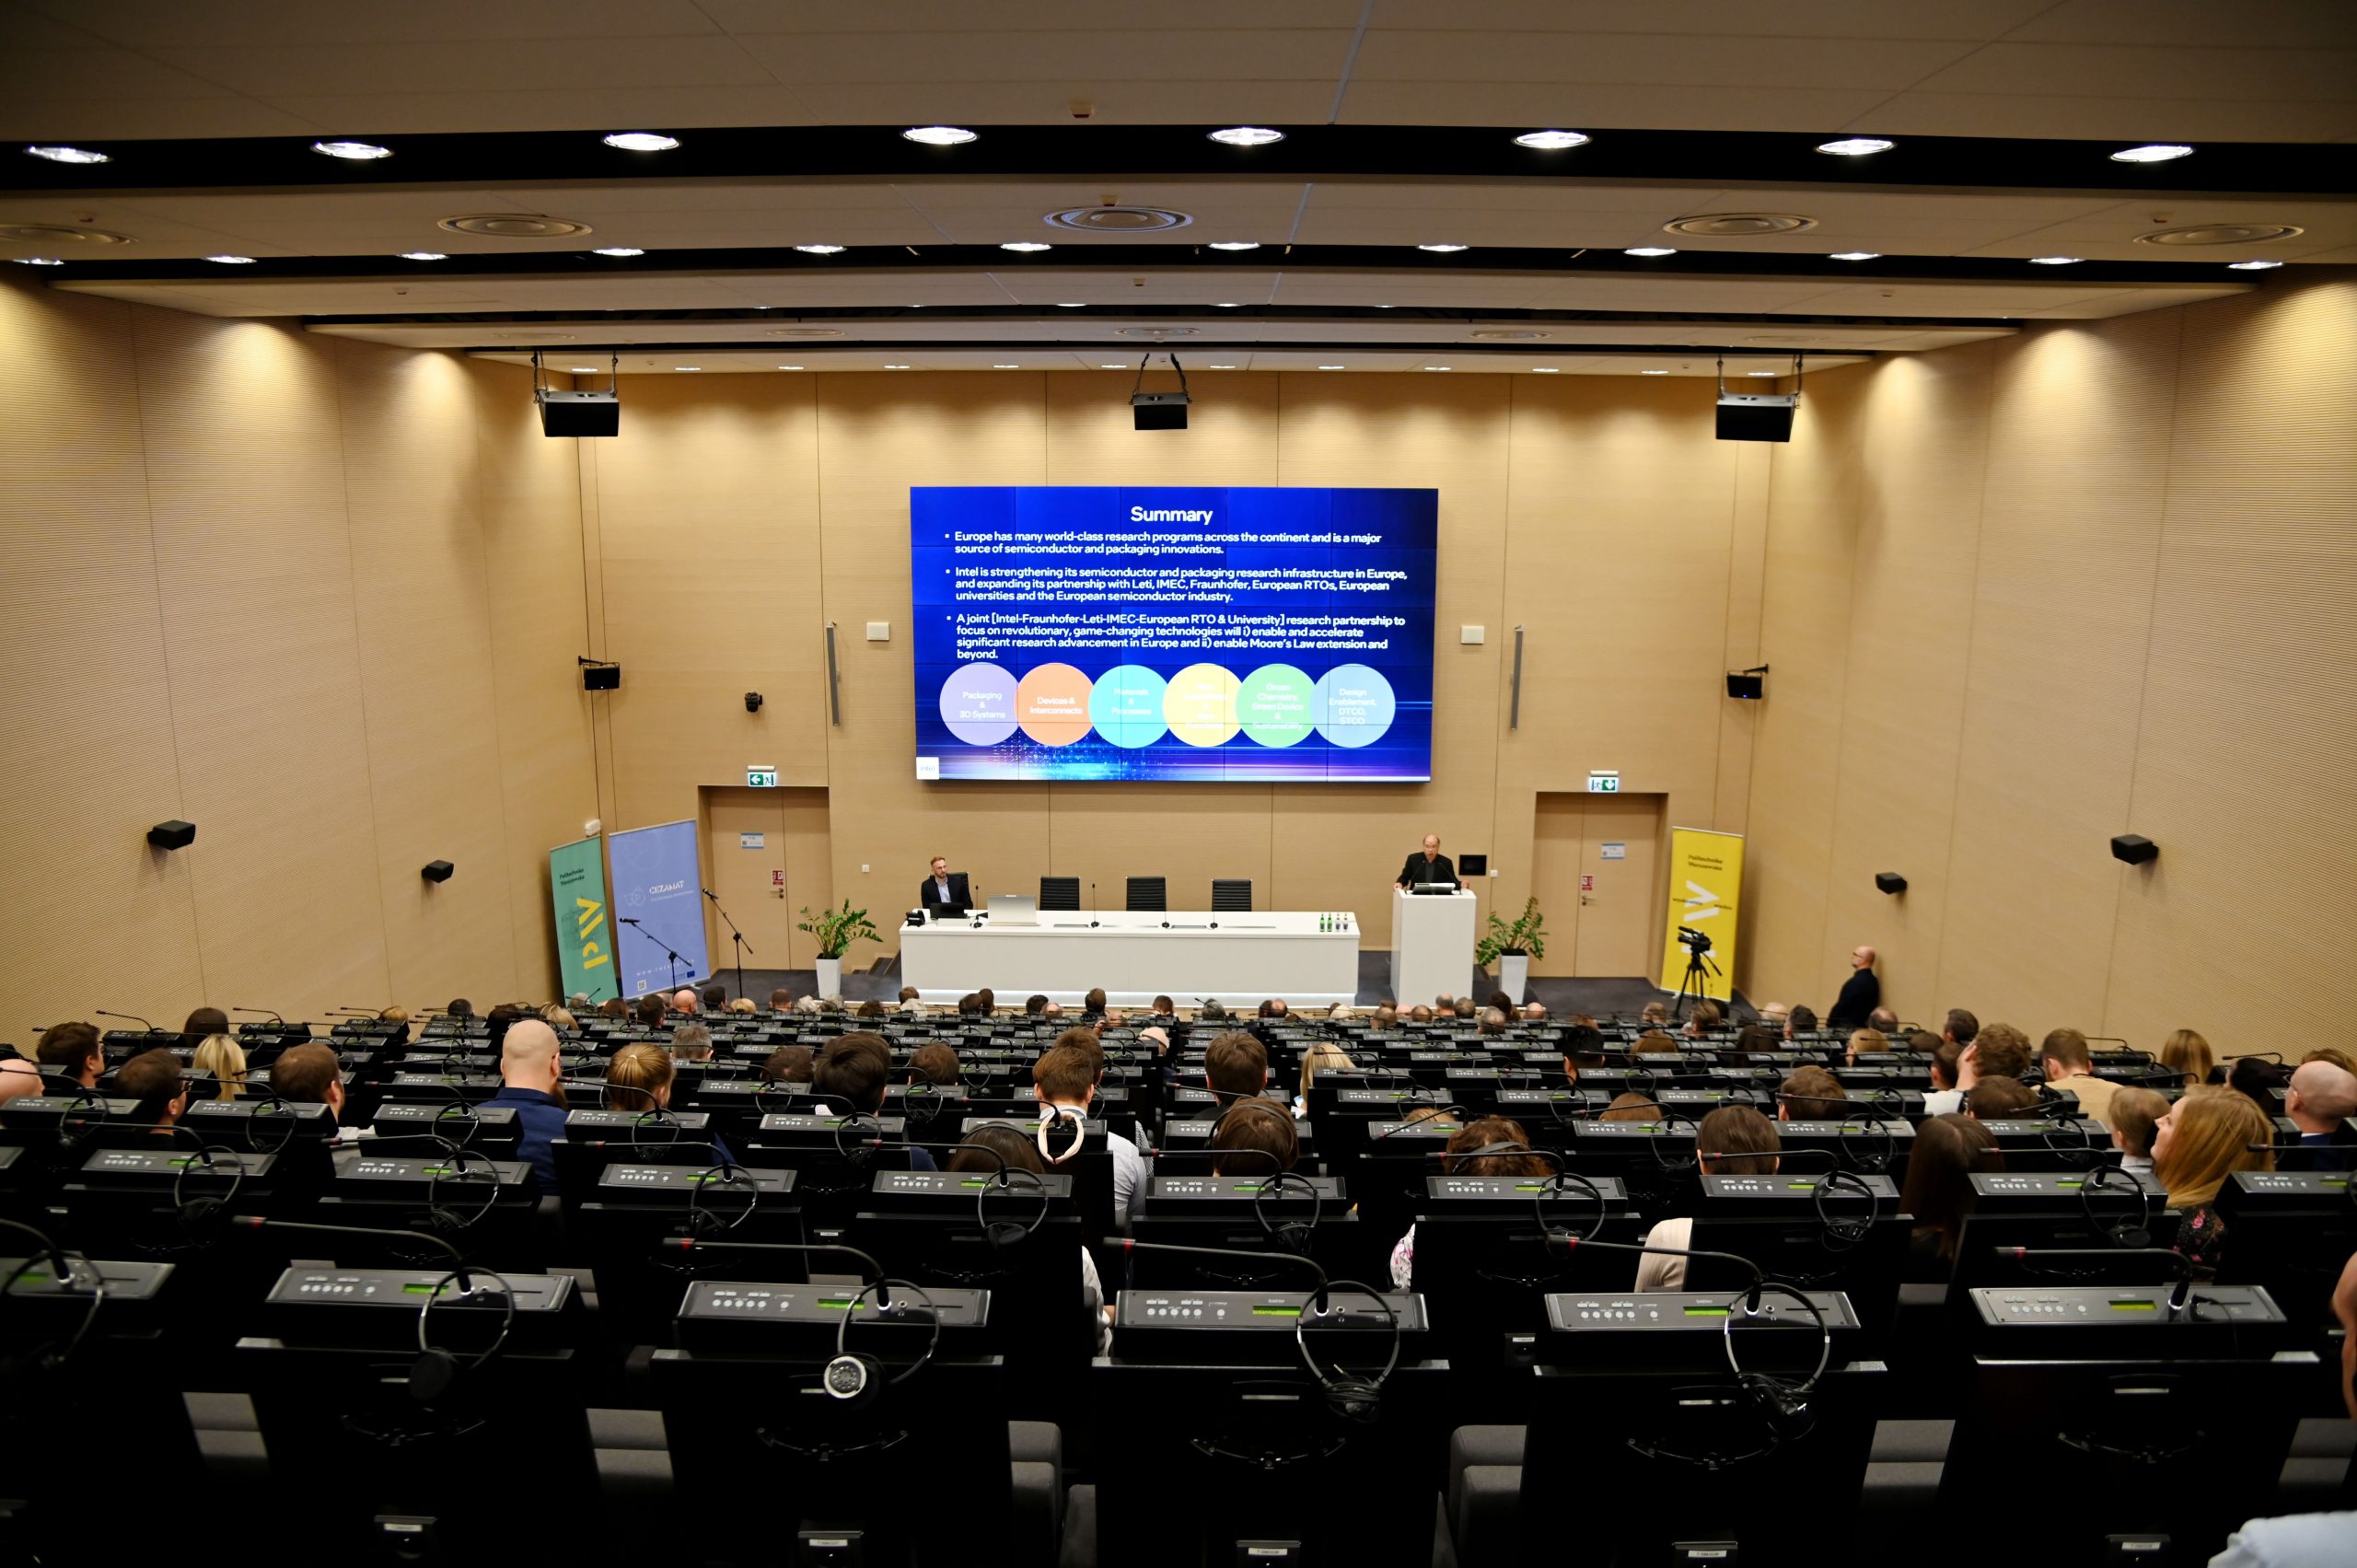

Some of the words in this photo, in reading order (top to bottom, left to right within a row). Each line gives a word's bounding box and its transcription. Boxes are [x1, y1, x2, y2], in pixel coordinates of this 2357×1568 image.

[1131, 506, 1213, 525] Summary
[955, 531, 993, 542] Europe
[994, 531, 1013, 540] has
[1016, 534, 1042, 543] many
[1045, 531, 1103, 540] world-class
[1106, 531, 1150, 541] research
[1153, 534, 1202, 543] programs
[1241, 532, 1259, 541] the
[1260, 533, 1309, 542] continent
[1311, 533, 1330, 542] and
[1333, 533, 1341, 542] is
[1352, 533, 1381, 545] major
[992, 543, 1003, 552] of
[1004, 542, 1083, 553] semiconductor
[1085, 543, 1104, 553] and
[1106, 542, 1159, 555] packaging
[1162, 544, 1224, 553] innovations.
[956, 567, 979, 576] Intel
[981, 567, 989, 576] is
[991, 567, 1062, 578] strengthening
[1064, 567, 1077, 576] its
[1079, 567, 1157, 576] semiconductor
[1159, 567, 1179, 576] and
[1181, 567, 1235, 579] packaging
[1237, 568, 1281, 577] research
[1283, 568, 1354, 578] infrastructure
[1355, 569, 1364, 578] in
[1367, 569, 1407, 580] Europe,
[956, 579, 975, 588] and
[977, 579, 1030, 590] expanding
[1032, 579, 1045, 588] its
[1047, 579, 1106, 590] partnership
[1108, 579, 1130, 588] with
[1132, 579, 1155, 589] Leti,
[1157, 578, 1189, 589] IMEC,
[1190, 578, 1251, 590] Fraunhofer,
[1252, 580, 1302, 591] European
[1305, 580, 1337, 590] RTOs,
[1340, 581, 1389, 592] European
[957, 591, 1014, 600] universities
[1016, 591, 1036, 600] and
[1038, 591, 1054, 600] the
[1057, 591, 1106, 602] European
[1108, 591, 1186, 600] semiconductor
[1189, 591, 1233, 603] industry.
[957, 614, 965, 622] A
[967, 614, 990, 625] joint
[992, 613, 1189, 625] [Intel-Fraunhofer-Leti-IMEC-European
[1191, 614, 1215, 623] RTO
[1218, 615, 1225, 623] &
[1228, 614, 1284, 626] University]
[1286, 615, 1330, 624] research
[1333, 616, 1392, 628] partnership
[1394, 617, 1405, 625] to
[957, 626, 985, 634] focus
[1002, 626, 1072, 638] revolutionary,
[1074, 626, 1154, 637] game-changing
[1155, 626, 1222, 639] technologies
[1225, 626, 1241, 635] will
[1243, 626, 1250, 637] i)
[1252, 627, 1286, 636] enable
[1289, 627, 1307, 636] and
[1309, 626, 1363, 637] accelerate
[958, 637, 1010, 648] significant
[1012, 637, 1056, 646] research
[1058, 636, 1128, 647] advancement
[1130, 638, 1139, 646] in
[1142, 638, 1178, 649] Europe
[1180, 638, 1200, 647] and
[1202, 637, 1212, 648] ii)
[1213, 638, 1248, 647] enable
[1294, 639, 1314, 648] Law
[1317, 640, 1365, 648] extension
[1368, 639, 1387, 649] and
[958, 649, 998, 660] beyond.
[962, 691, 1002, 700] Packaging
[1339, 688, 1367, 696] Design
[972, 711, 1005, 720] Systems
[1029, 706, 1083, 714] Interconnects
[1340, 716, 1365, 725] STCO
[648, 880, 685, 895] CEZAMAT
